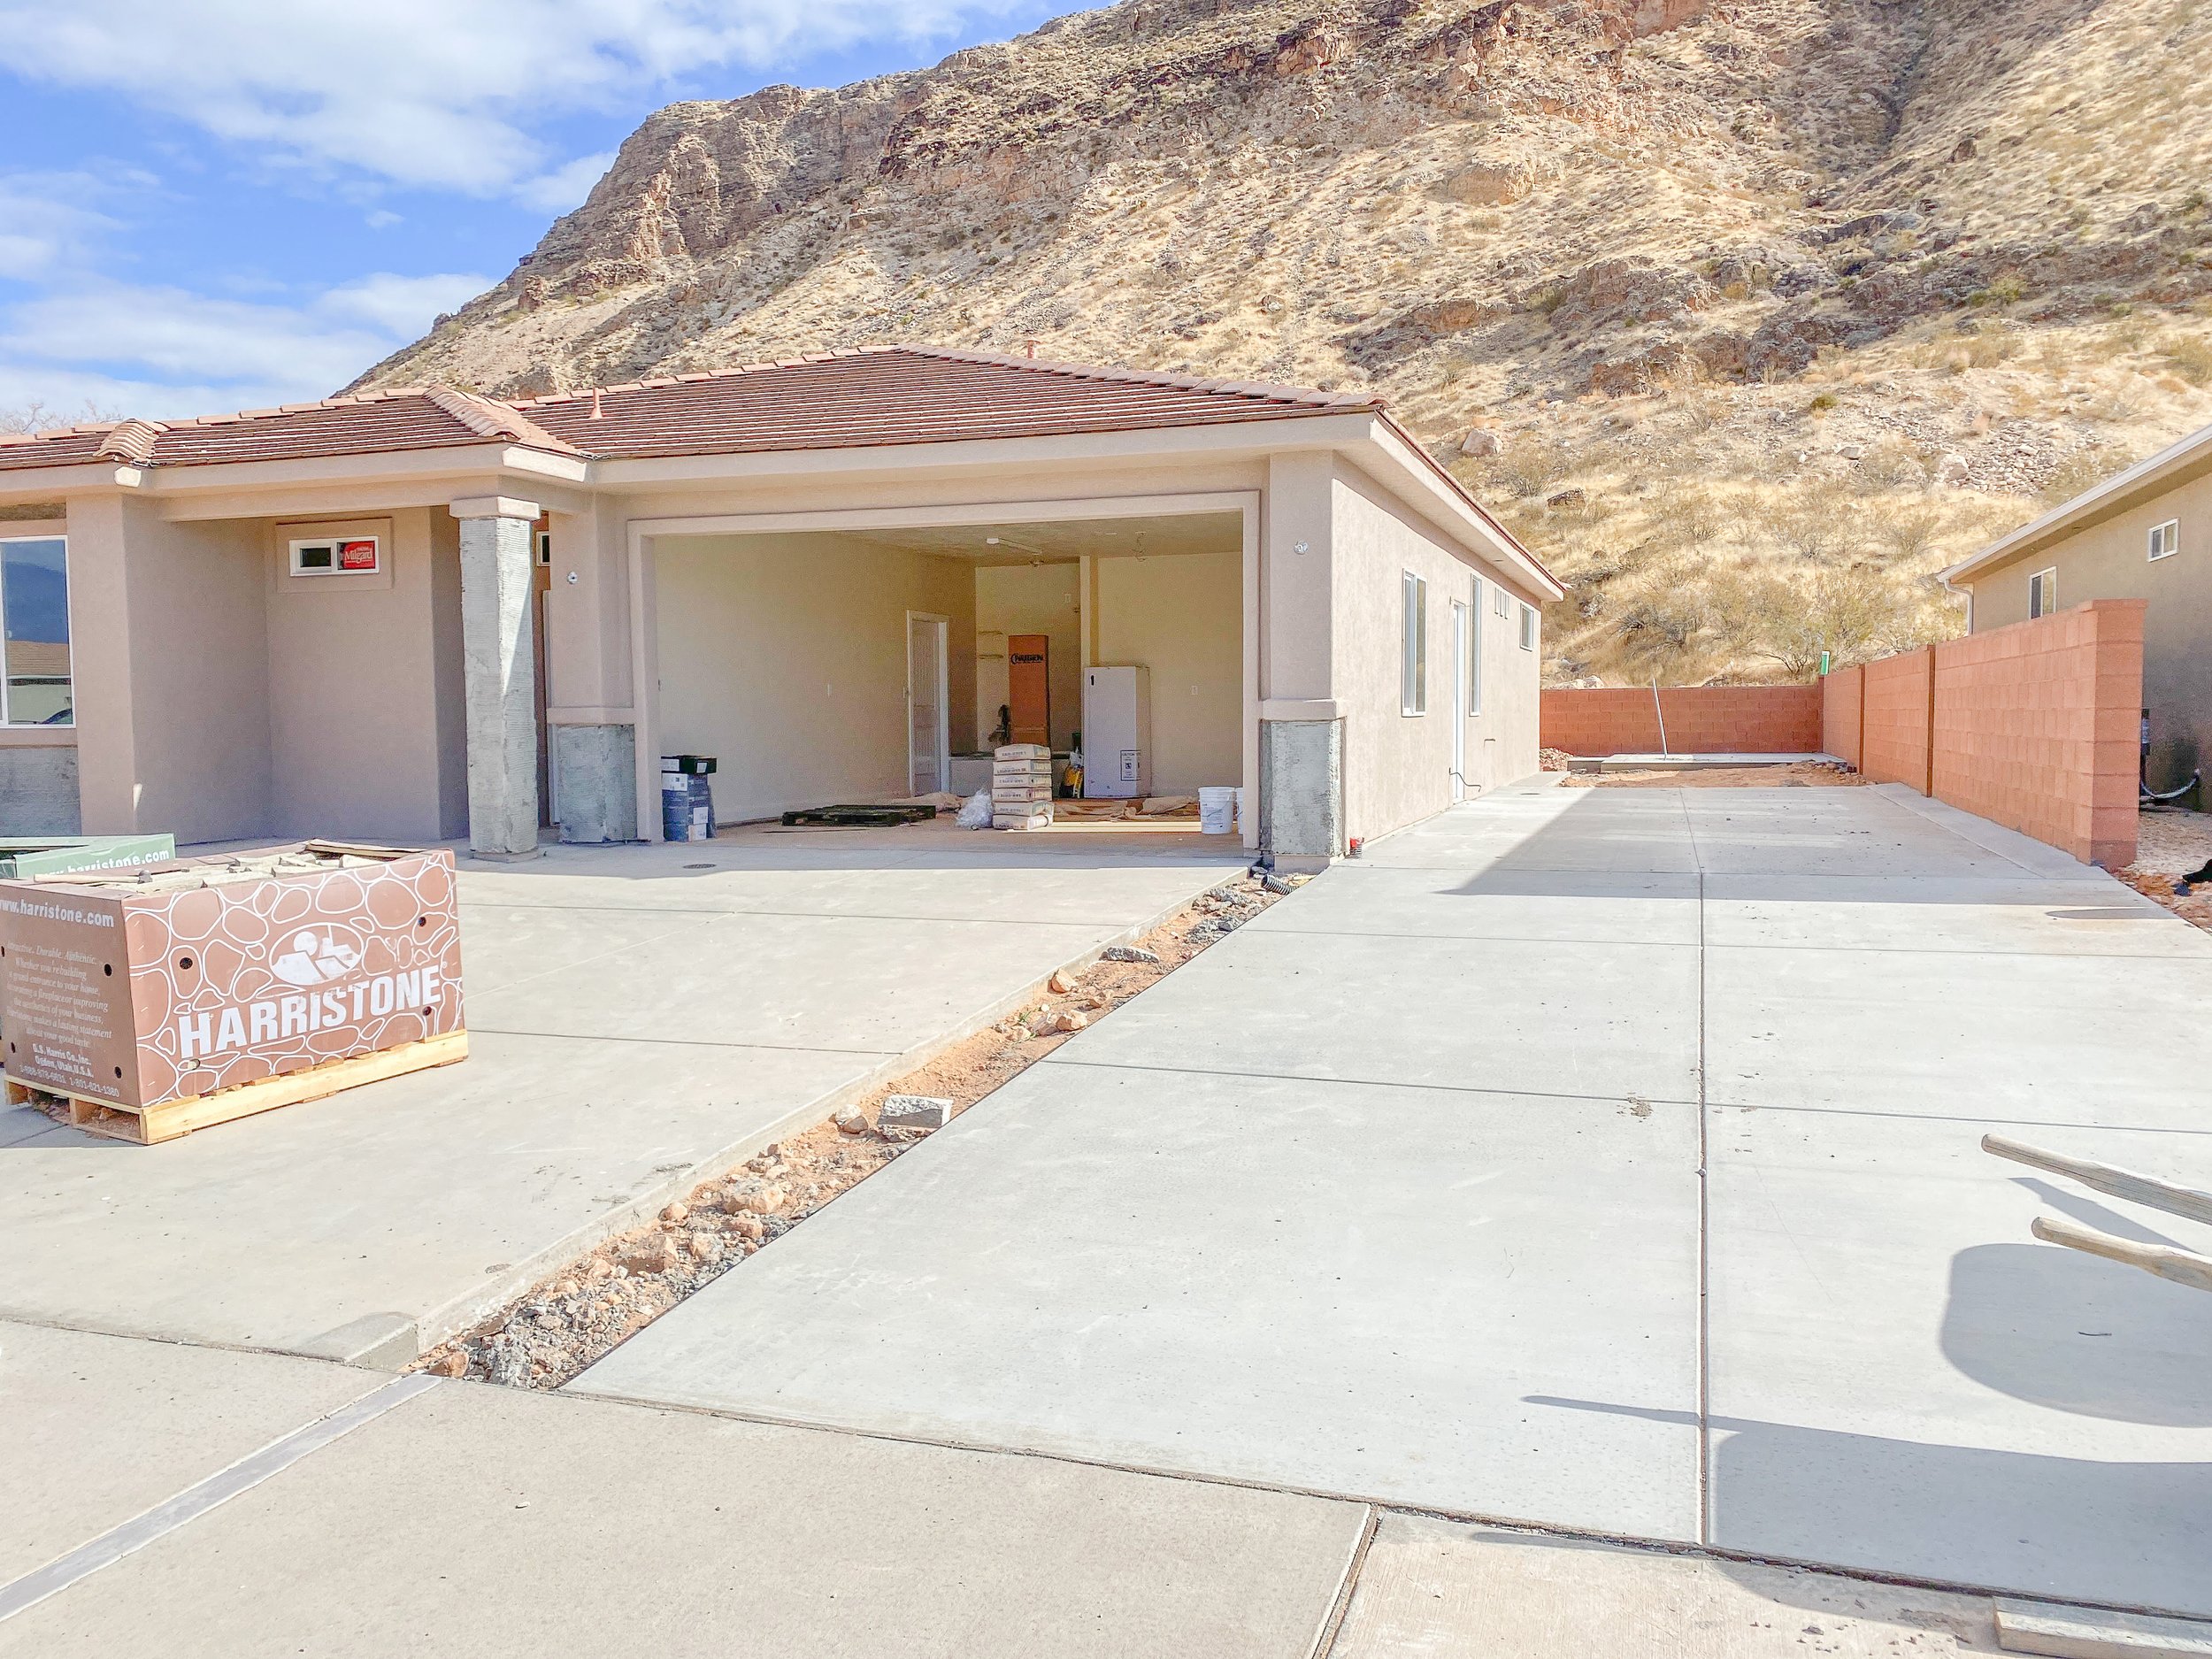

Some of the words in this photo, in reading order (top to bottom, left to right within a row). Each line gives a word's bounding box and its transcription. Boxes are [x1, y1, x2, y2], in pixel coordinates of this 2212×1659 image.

[345, 549, 373, 564] Milgard
[0, 898, 115, 928] ww.harristone.com
[178, 965, 442, 1058] HARRISTONE
